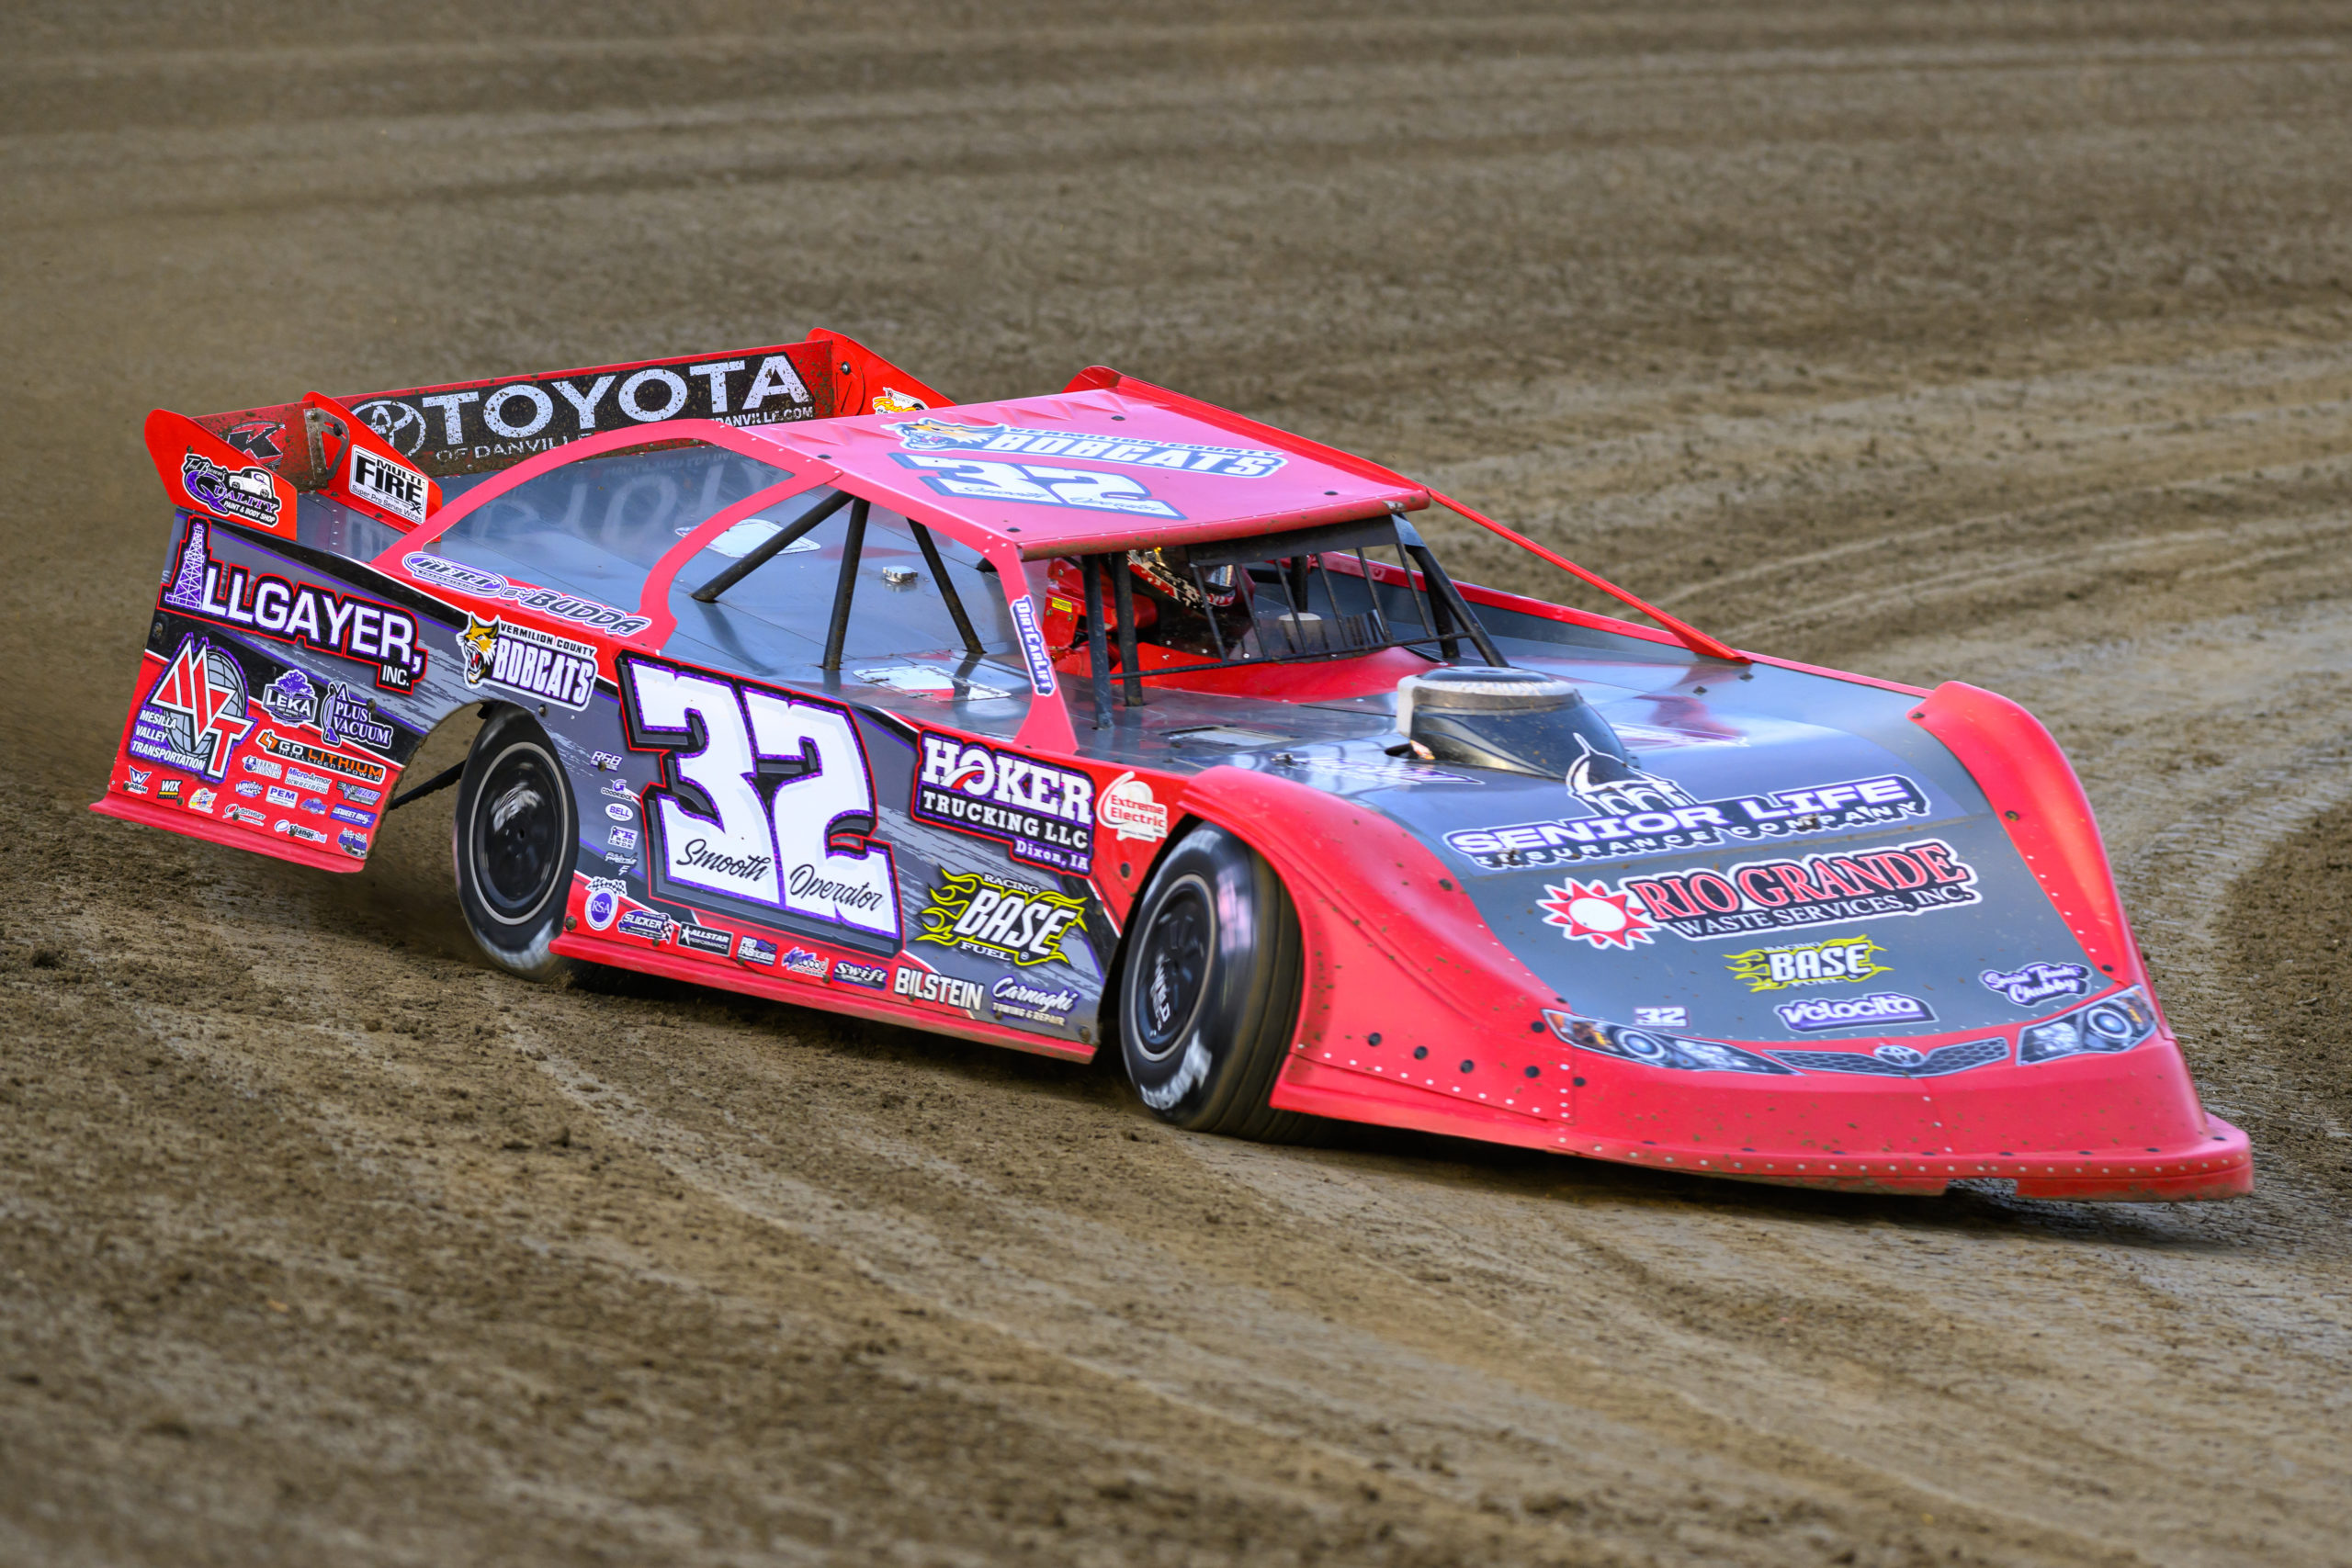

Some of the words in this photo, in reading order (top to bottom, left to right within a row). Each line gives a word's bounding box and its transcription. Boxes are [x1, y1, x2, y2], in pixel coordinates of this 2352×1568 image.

[423, 355, 811, 445] TOYOTA
[435, 447, 468, 462] OF
[982, 433, 1278, 475] BOBCATS
[1010, 428, 1158, 445] VERMILION
[1168, 443, 1280, 457] COUNTY
[185, 457, 200, 470] Ted
[198, 461, 227, 482] Brown's
[355, 455, 423, 506] FIRE
[377, 458, 425, 485] MULTI-
[186, 470, 278, 513] QUALITY
[899, 454, 1182, 518] 32
[223, 501, 241, 511] PAINT
[244, 507, 261, 517] BODY
[260, 513, 276, 523] SHOP
[352, 484, 370, 497] Super
[371, 493, 382, 502] Pro
[383, 498, 402, 513] Series
[403, 509, 423, 522] Wires
[526, 592, 647, 634] BUDDA
[500, 623, 554, 645] VERMILION
[556, 638, 595, 657] COUNTY
[382, 665, 410, 686] INC.
[492, 637, 593, 704] BOBCATS
[266, 688, 311, 716] LEKA
[337, 689, 347, 702] A
[139, 709, 177, 729] MESILLA
[334, 701, 368, 721] PLUS
[135, 725, 168, 743] VALLEY
[333, 716, 390, 744] VACUUM
[131, 740, 207, 770] TRANSPORTATION
[256, 759, 281, 770] HOOKER
[278, 740, 303, 755] GO
[308, 747, 384, 777] LITHIUM
[254, 766, 281, 779] HARNESS
[288, 768, 332, 784] Micro-Armor
[345, 767, 380, 781] POWER
[922, 737, 1092, 825] HOKER
[161, 781, 181, 792] WIX
[270, 787, 295, 800] PEM
[629, 660, 899, 936] 32
[609, 806, 630, 818] BELL
[1111, 795, 1164, 815] Extreme
[1111, 807, 1165, 828] Electric
[1452, 805, 1732, 852] SENIOR
[1739, 778, 1911, 820] LIFE
[923, 791, 1039, 837] TRUCKING
[1045, 822, 1088, 849] LLC
[1476, 829, 1713, 864] INSURANCE
[1730, 802, 1917, 835] COMPANY
[613, 829, 635, 840] FK
[1069, 852, 1089, 871] IA
[676, 839, 772, 882] Smooth
[789, 863, 885, 911] Operator
[983, 874, 1040, 895] RACING
[1631, 874, 1739, 920] RIO
[1738, 844, 1968, 907] GRANDE
[592, 900, 611, 914] RSA
[1675, 908, 1780, 936] WASTE
[1781, 895, 1913, 924] SERVICES,
[1917, 885, 1972, 905] INC.
[624, 913, 662, 930] SLICKER
[953, 888, 1078, 955] BASE
[690, 929, 729, 942] ALLSTAR
[690, 938, 728, 950] PERFORMANCE
[961, 942, 1012, 961] FUEL
[1770, 943, 1872, 982] BASE
[835, 962, 888, 983] Swift
[894, 966, 984, 1010] BILSTEIN
[992, 976, 1078, 1012] Carnaghi
[1635, 1007, 1687, 1027] 32
